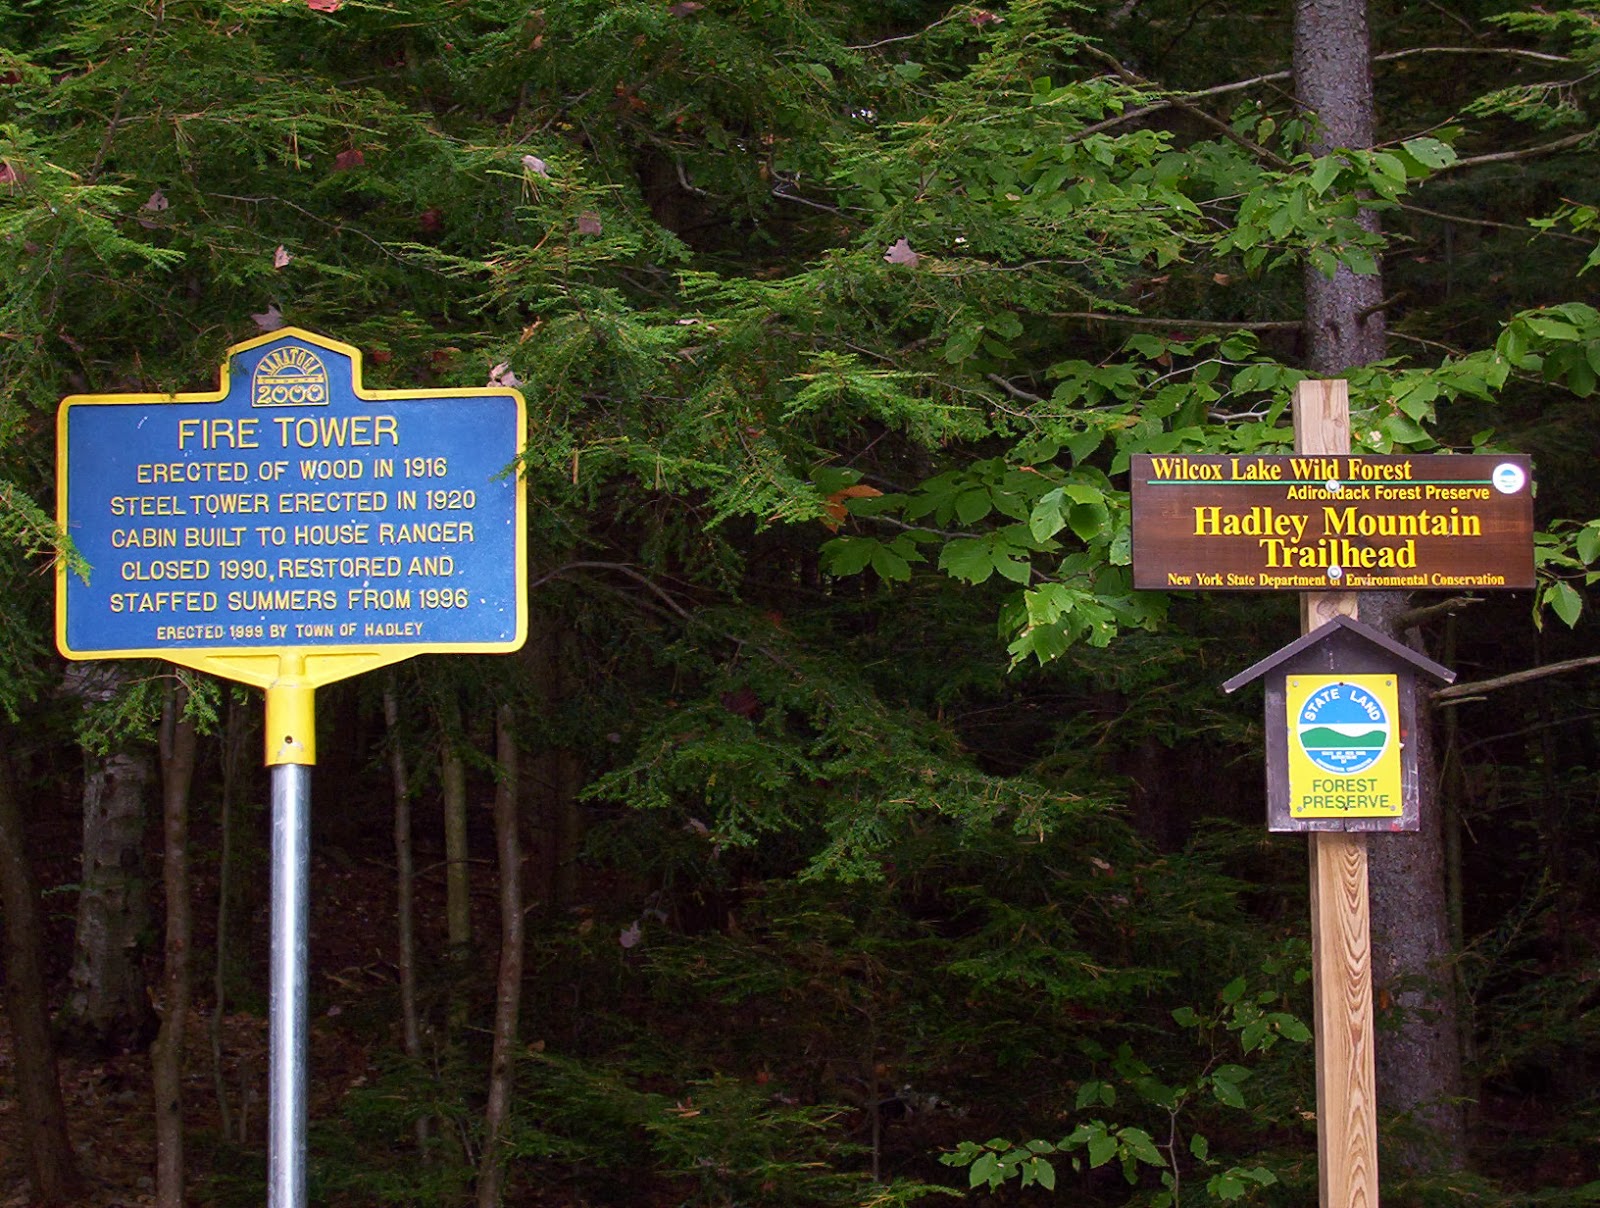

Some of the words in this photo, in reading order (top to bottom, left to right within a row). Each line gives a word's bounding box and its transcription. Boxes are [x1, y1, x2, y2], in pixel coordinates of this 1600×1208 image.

[256, 384, 324, 404] 2000
[178, 418, 259, 450] FIRE
[273, 416, 399, 448] TOWER
[137, 462, 248, 484] ERECTED
[258, 461, 289, 481] OF
[300, 459, 363, 480] WOOD
[374, 458, 394, 479] IN
[403, 457, 447, 479] 1916
[1151, 457, 1223, 480] Wilcox
[1230, 458, 1282, 480] Lake
[1289, 458, 1340, 480] Wild
[1347, 458, 1413, 480] Forest
[110, 496, 187, 516] STEEL
[189, 494, 270, 515] TOWER
[279, 491, 388, 513] ERECTED
[397, 490, 417, 511] IN
[426, 489, 476, 511] 1920
[1286, 484, 1371, 500] Adirondack
[1374, 485, 1422, 500] Forest
[1425, 485, 1490, 500] Preserve
[111, 528, 177, 548] CABIN
[185, 527, 247, 547] BUILT
[256, 526, 287, 547] TO
[294, 524, 370, 546] HOUSE
[379, 522, 474, 544] RANGER
[1193, 506, 1309, 544] Hadley
[1322, 506, 1482, 536] Mountain
[1259, 538, 1417, 568] Trailhead
[121, 560, 210, 581] CLOSED
[219, 560, 275, 583] 1990,
[278, 556, 402, 579] RESTORED
[407, 555, 455, 577] AND
[1168, 572, 1191, 586] New
[1196, 572, 1224, 586] York
[1226, 572, 1256, 586] State
[1259, 573, 1326, 589] Department
[1346, 573, 1428, 587] Environmental
[1431, 572, 1505, 586] Conservation
[110, 592, 218, 613] STAFFED
[227, 590, 338, 612] SUMMERS
[347, 588, 411, 610] FROM
[419, 588, 470, 609] 1996
[156, 625, 224, 640] ERECTED
[230, 625, 263, 639] 1999
[269, 624, 288, 638] BY
[295, 624, 334, 638] TOWN
[339, 623, 358, 637] OF
[364, 621, 424, 637] HADLEY
[1304, 688, 1341, 722] STATE
[1349, 689, 1381, 721] LAND
[1312, 778, 1378, 793] FOREST
[1302, 794, 1389, 809] PRESERVE
